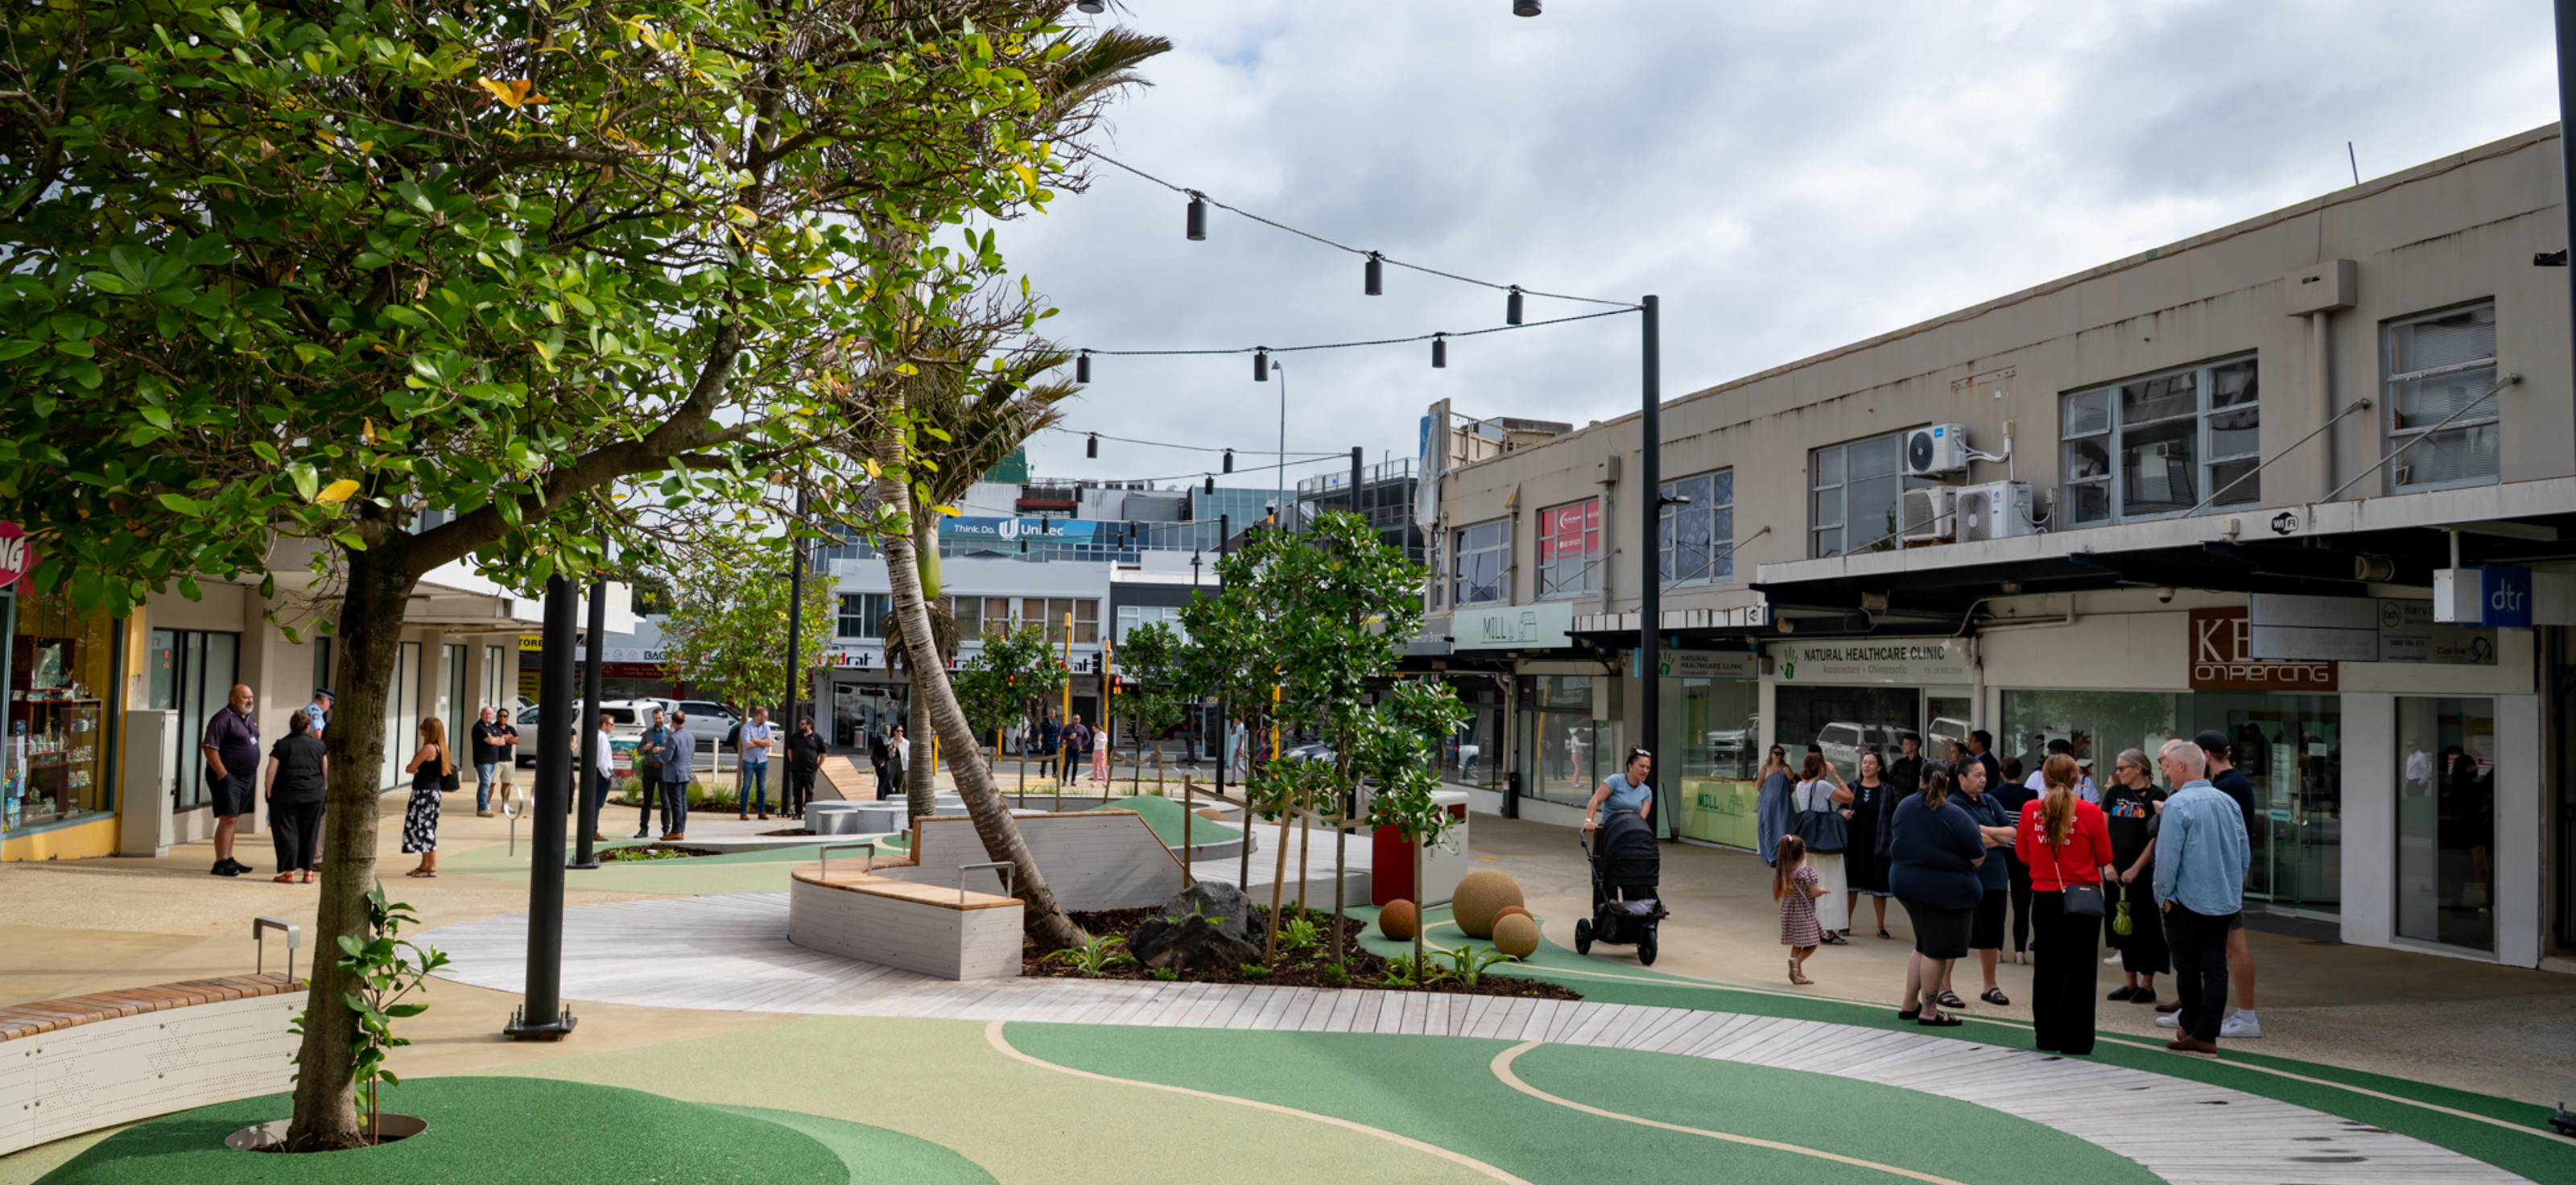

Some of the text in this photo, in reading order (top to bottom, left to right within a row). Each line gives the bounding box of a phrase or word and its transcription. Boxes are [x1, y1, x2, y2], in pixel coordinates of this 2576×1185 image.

[954, 524, 995, 534] Think. Do.
[1021, 523, 1064, 536] Uniec
[2491, 577, 2524, 612] dtr
[1483, 616, 1507, 640] MILL
[1680, 654, 1710, 663] NATURAL
[1804, 646, 1945, 662] NATURAL HEALTHCARE CLINIC
[1680, 662, 1744, 671] HEALTHCARE CLINIC
[1823, 664, 1908, 675] Acupuncture Chiropractic
[1697, 793, 1719, 809] MILL
